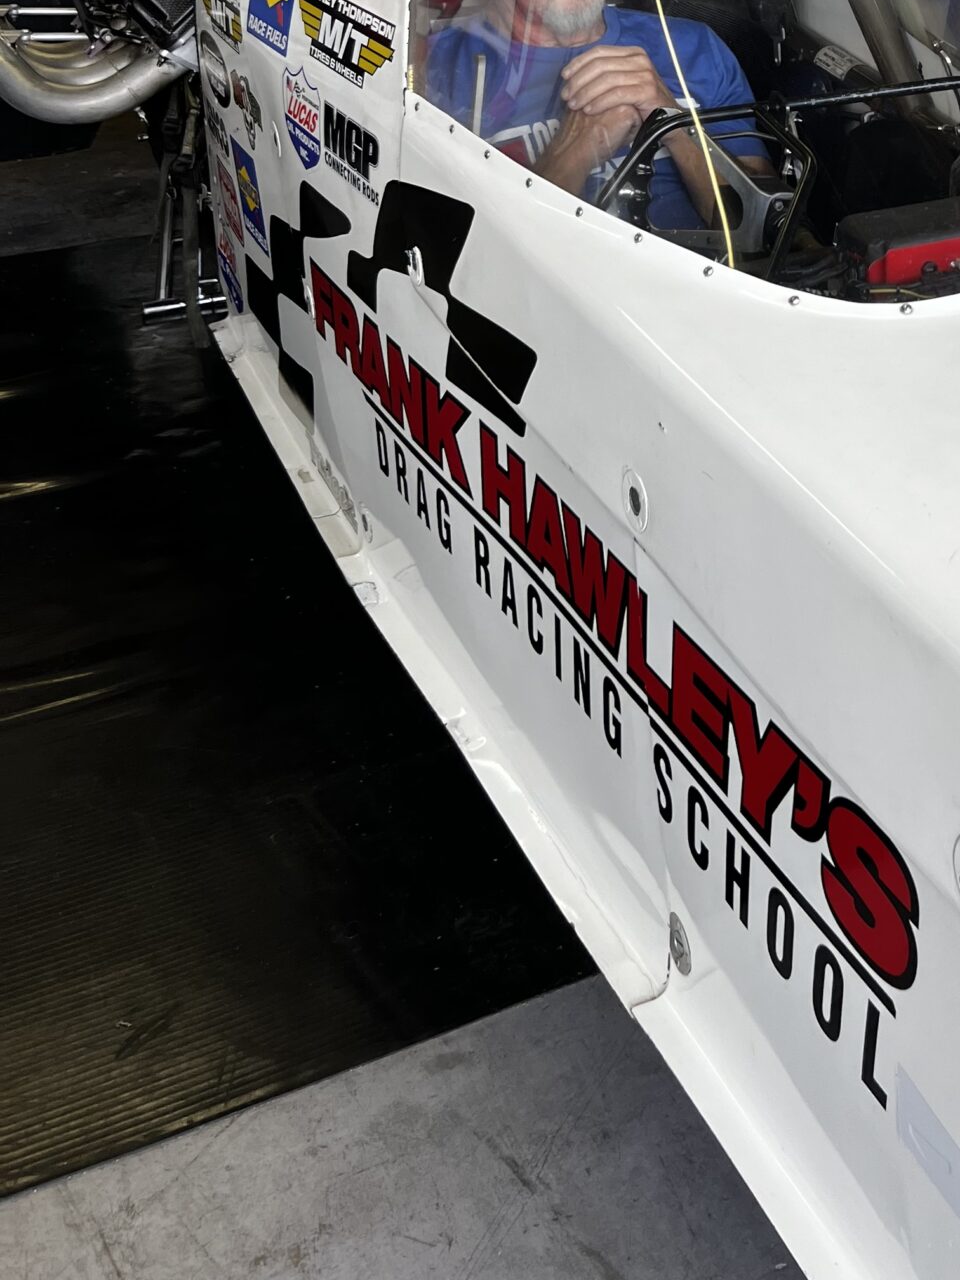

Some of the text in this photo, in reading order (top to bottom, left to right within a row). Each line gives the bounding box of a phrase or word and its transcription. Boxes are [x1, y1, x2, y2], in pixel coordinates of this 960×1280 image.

[248, 14, 267, 36] RACE
[267, 24, 288, 48] FUELS
[318, 13, 370, 66] M/T
[309, 45, 331, 66] TIRES
[335, 59, 363, 87] WHEELS
[287, 95, 319, 133] LUCAS
[324, 99, 380, 183] MGP
[324, 151, 380, 207] CONNECTING RODS
[310, 256, 920, 990] FRANK HAWLEY'S
[374, 417, 888, 1111] DRAG RACING SCHOOL
